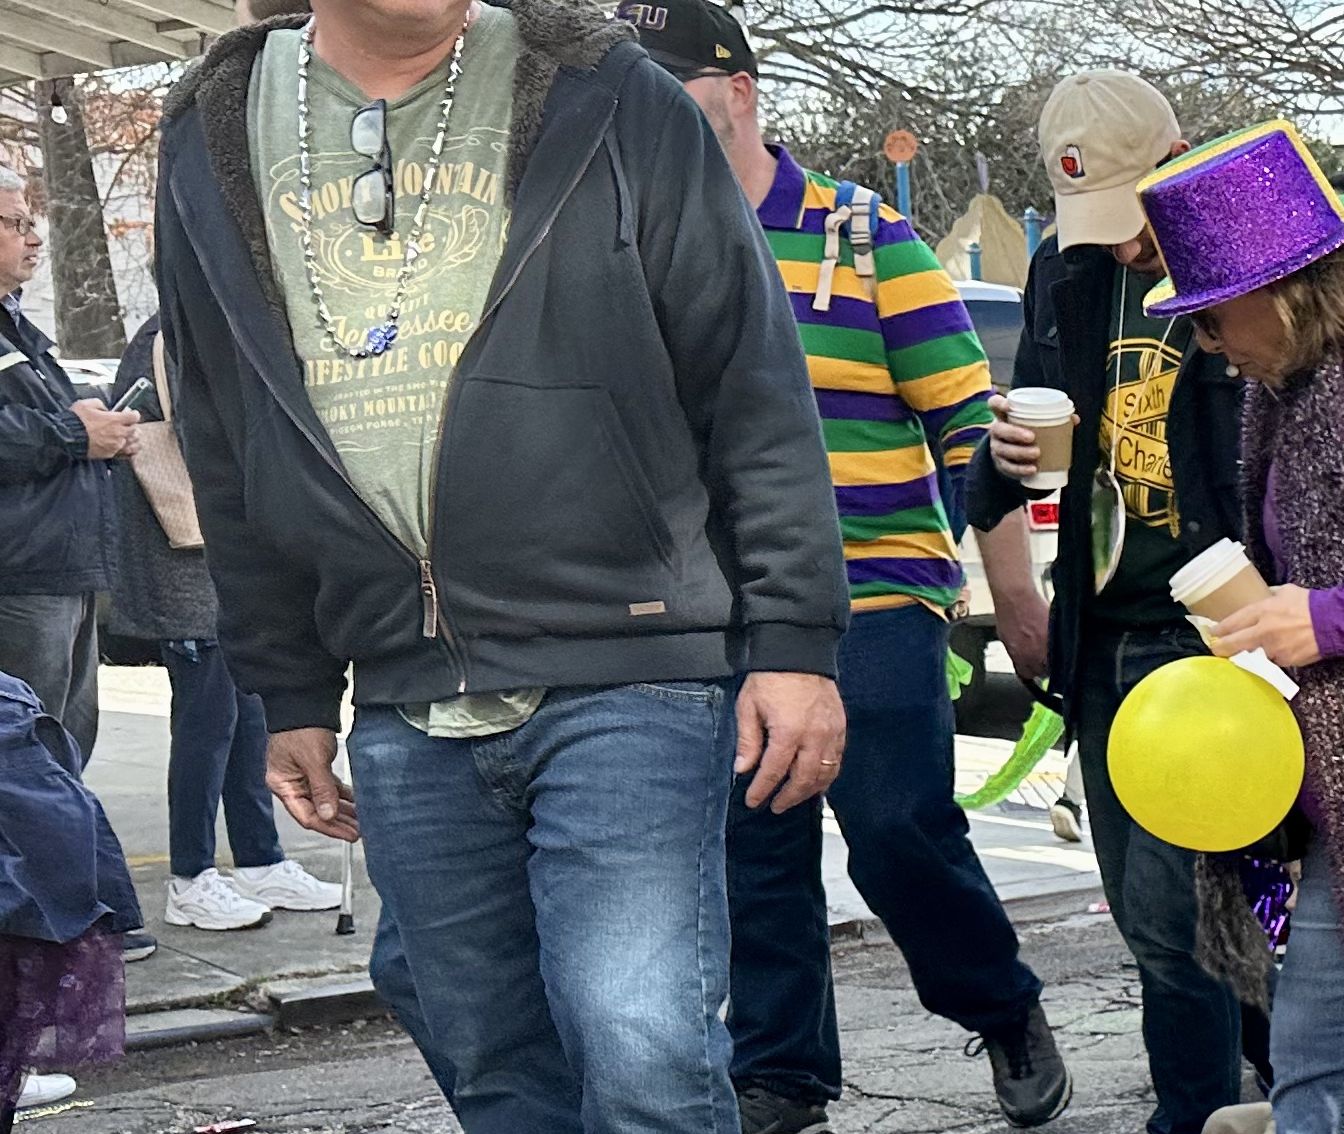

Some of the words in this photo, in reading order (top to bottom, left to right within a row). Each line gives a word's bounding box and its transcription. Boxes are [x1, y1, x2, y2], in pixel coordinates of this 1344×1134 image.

[385, 158, 502, 206] MONTAIN
[358, 231, 436, 262] Lie
[373, 258, 428, 278] BRD
[364, 291, 429, 320] QULITY
[304, 346, 409, 387] IFESTYLE
[363, 391, 436, 417] MOUNTAI
[1123, 382, 1166, 418] Sixth
